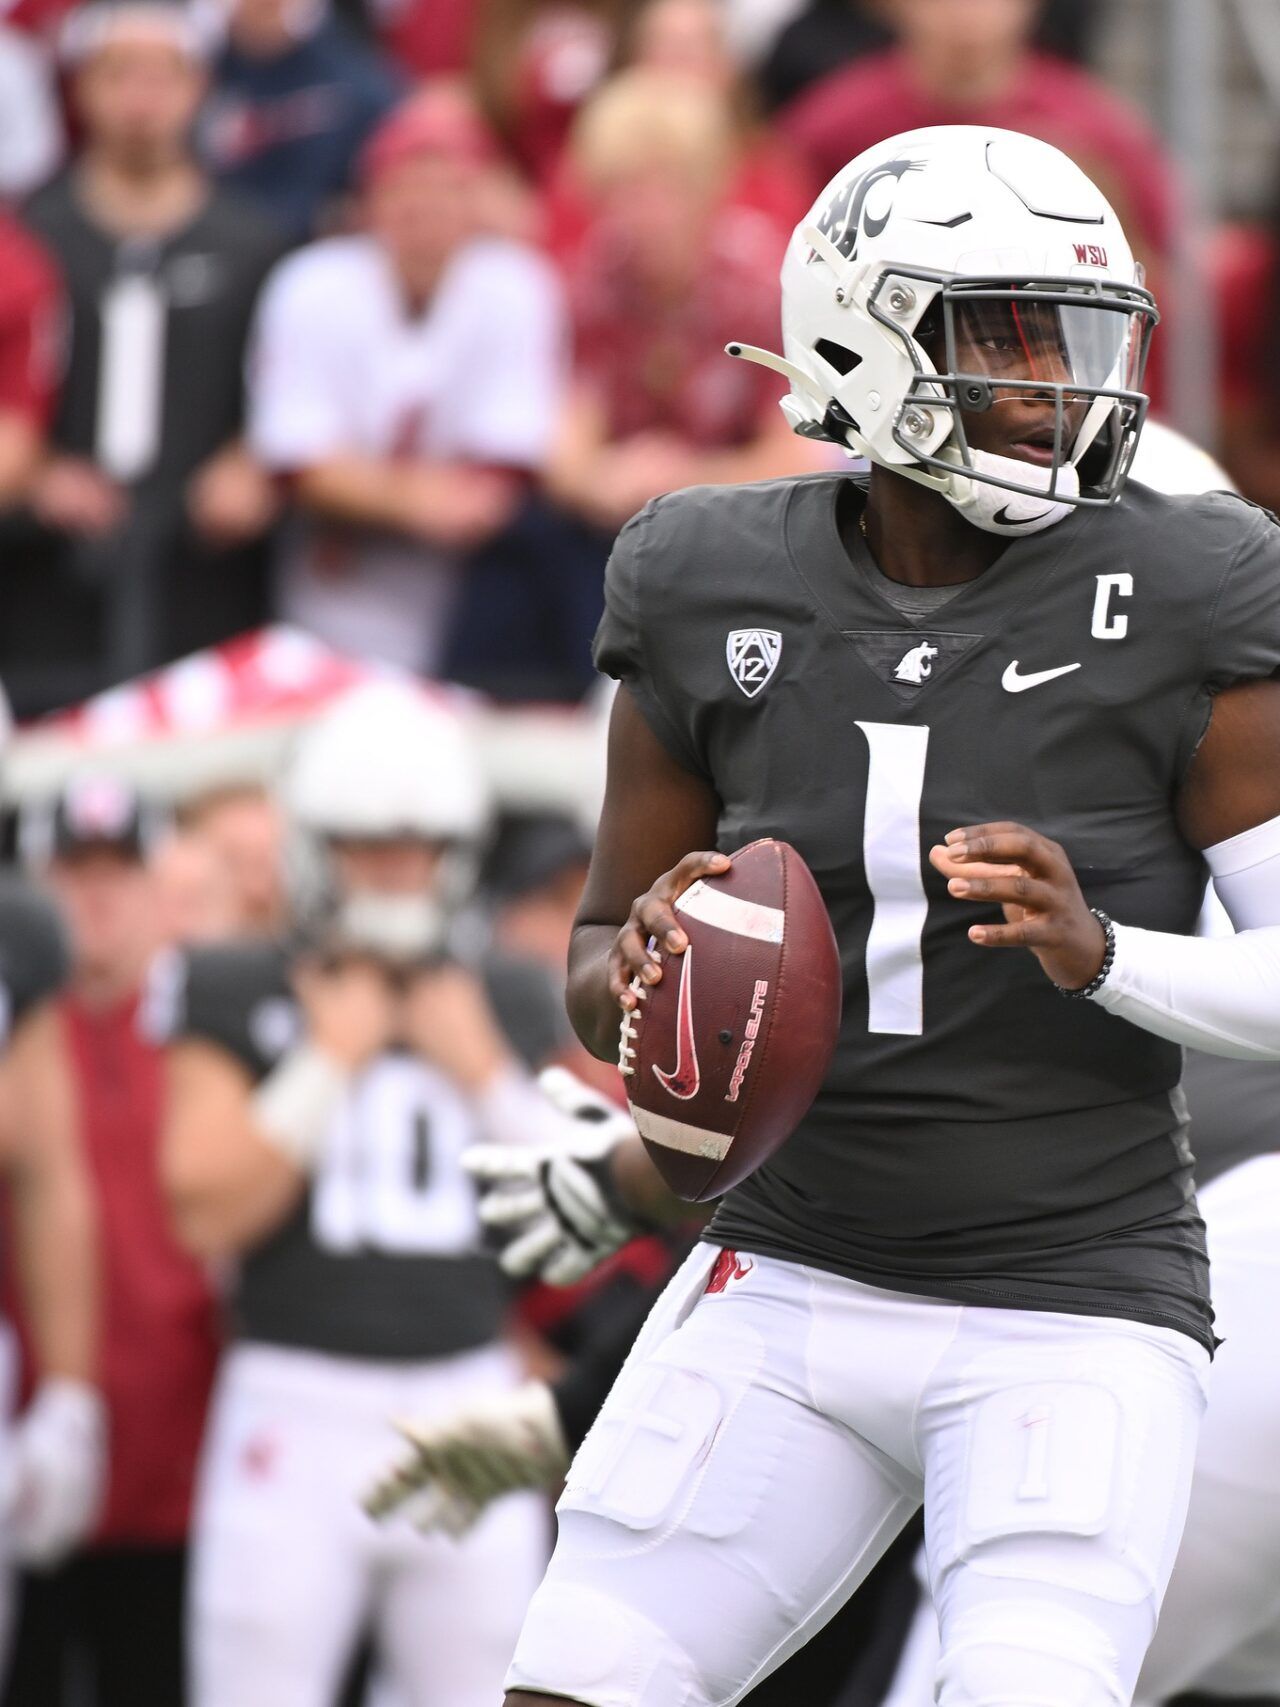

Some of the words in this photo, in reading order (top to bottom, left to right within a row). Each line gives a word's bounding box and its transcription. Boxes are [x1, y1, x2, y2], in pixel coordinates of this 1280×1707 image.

[1072, 243, 1108, 267] WSU
[1091, 572, 1134, 640] C
[729, 631, 780, 669] PAC
[738, 657, 766, 682] 12
[853, 720, 930, 1036] 1
[724, 1040, 755, 1102] VAPOR
[744, 979, 769, 1040] ELITE
